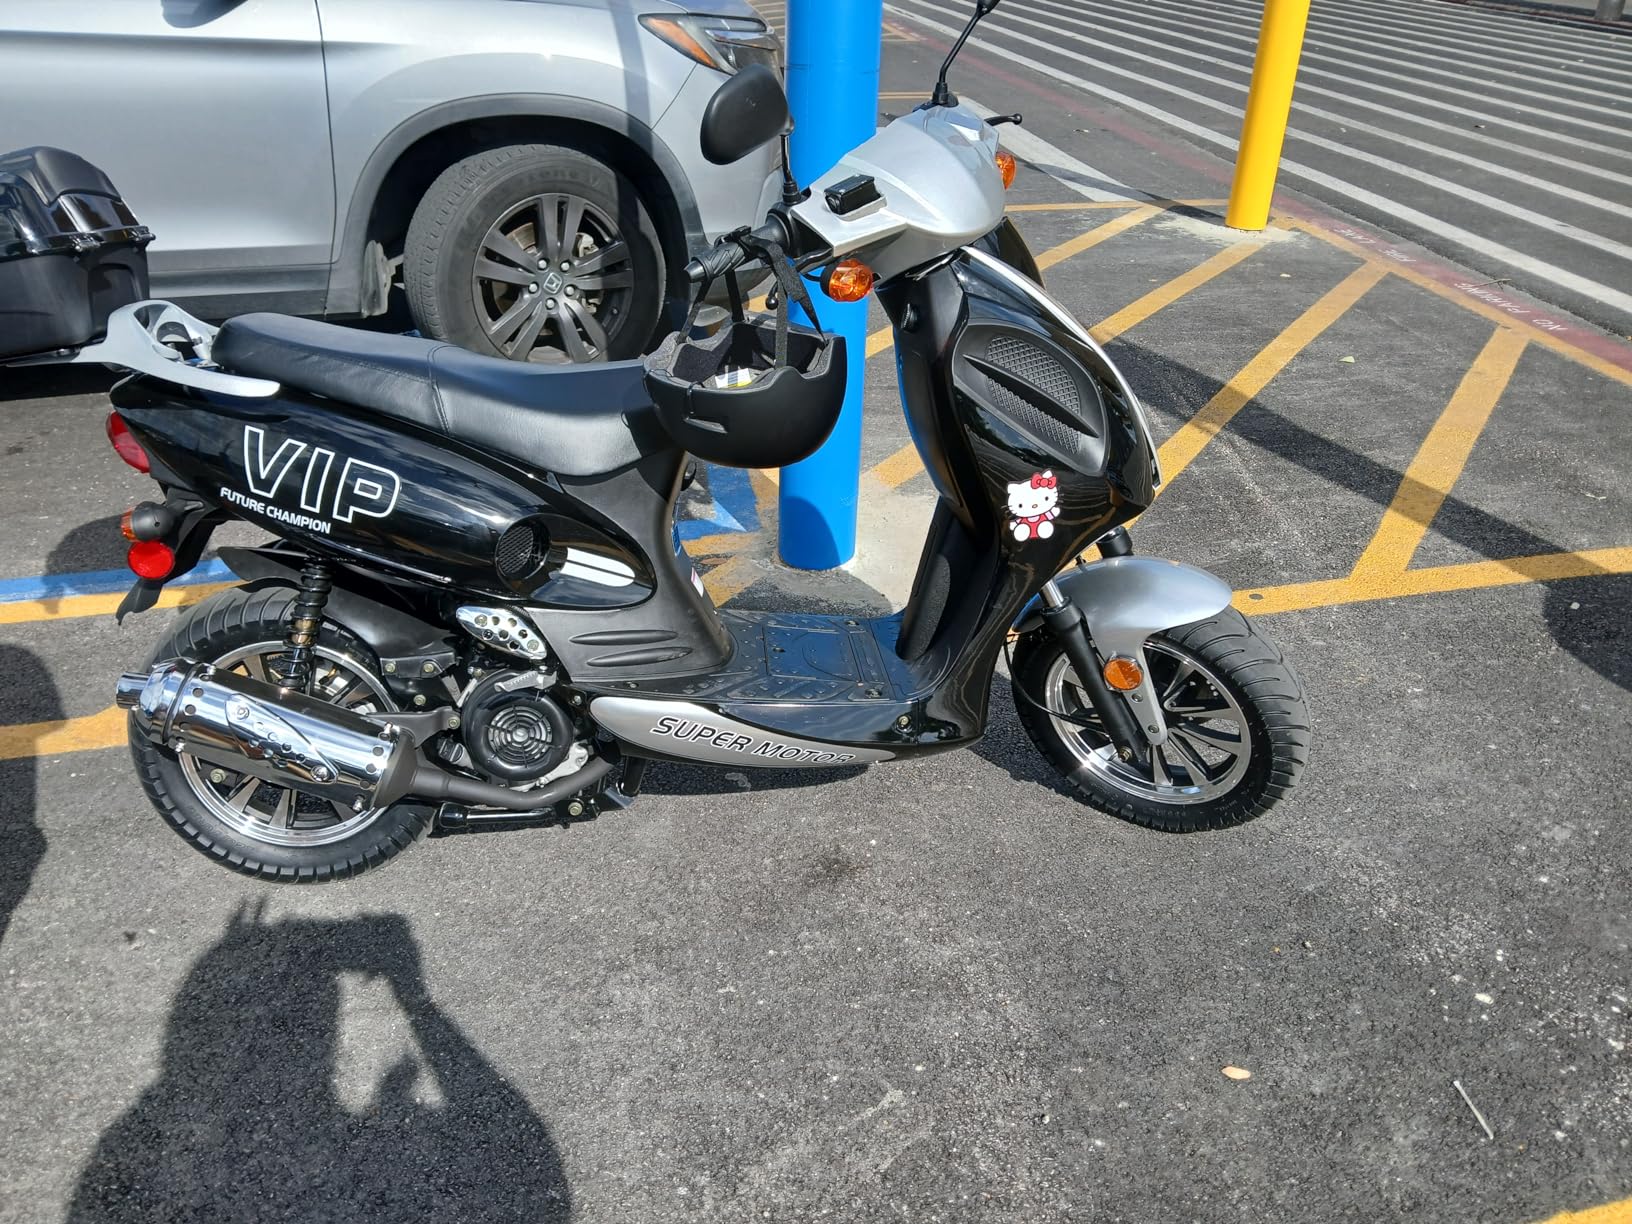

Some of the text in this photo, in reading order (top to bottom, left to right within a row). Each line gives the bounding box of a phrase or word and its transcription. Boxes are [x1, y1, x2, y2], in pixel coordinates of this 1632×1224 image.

[1453, 282, 1569, 331] NO PARKING
[243, 424, 401, 524] VIP
[220, 486, 332, 535] FUTURE CHAMPION
[651, 716, 856, 764] SUPER MOTOR
